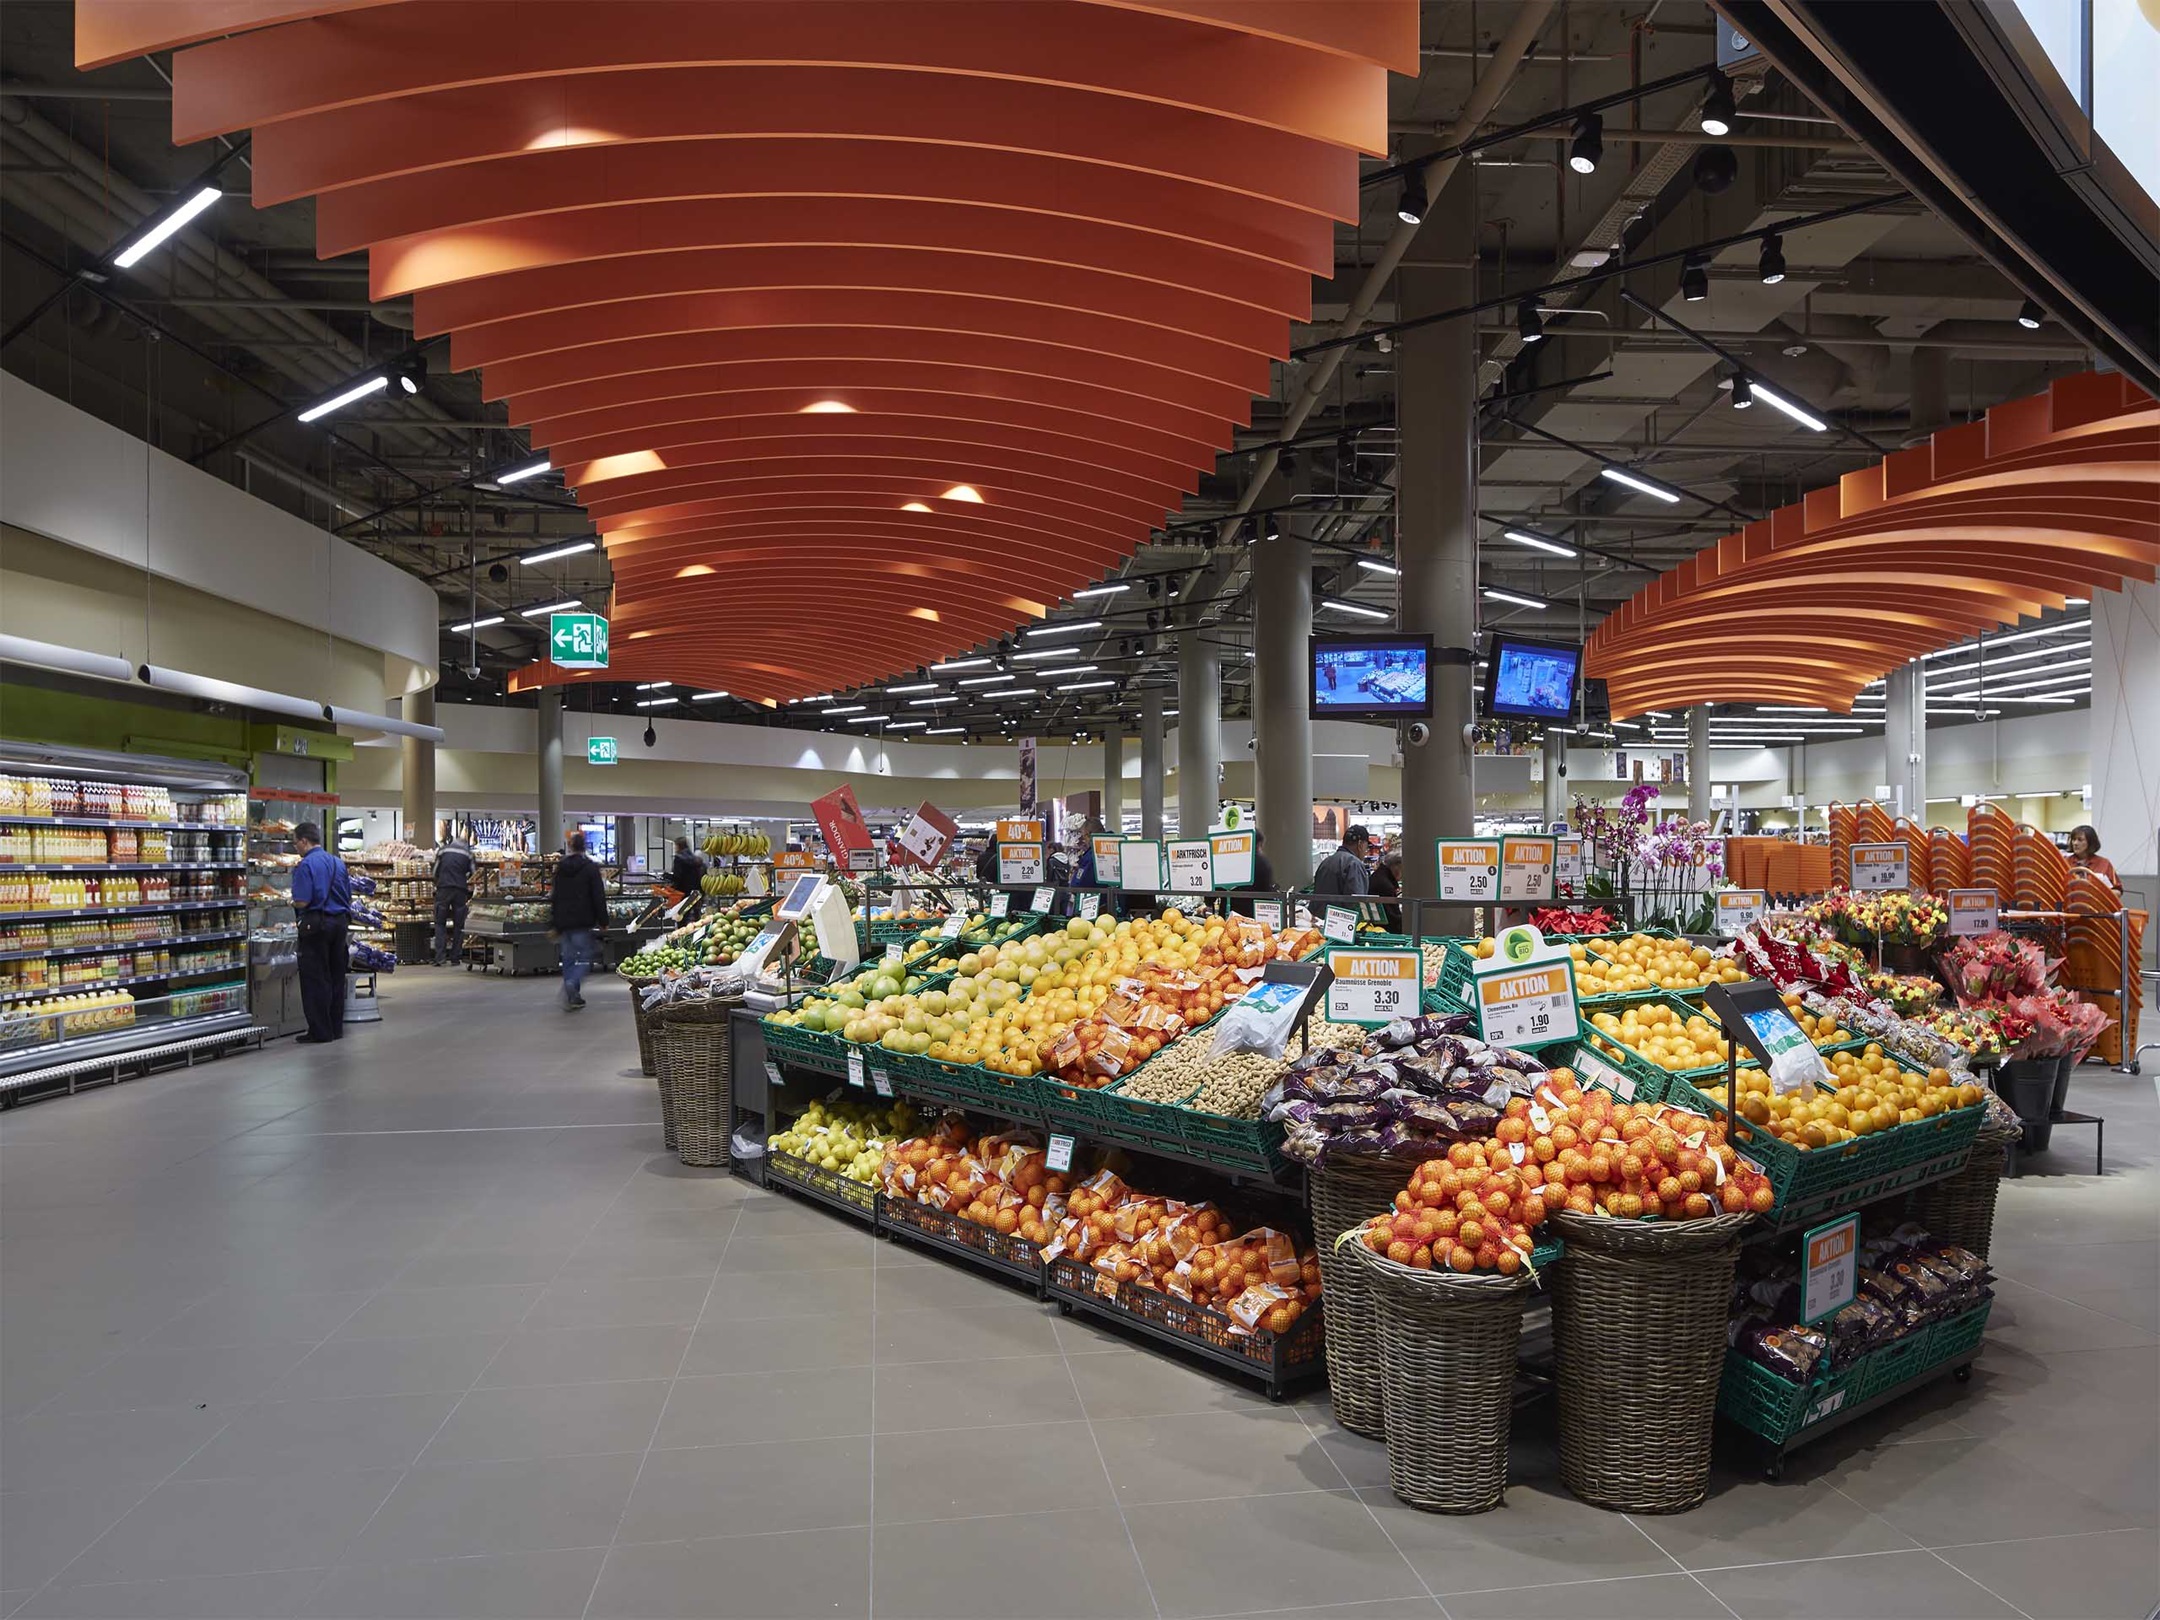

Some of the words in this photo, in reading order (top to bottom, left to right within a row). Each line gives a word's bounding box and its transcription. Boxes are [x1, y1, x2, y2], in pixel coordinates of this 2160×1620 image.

[1008, 824, 1031, 840] 40%
[829, 820, 848, 859] GIANDOR
[1218, 839, 1243, 853] AKTION
[1009, 849, 1032, 858] AKTION
[1171, 849, 1207, 861] MARKTFRISCH
[1453, 848, 1486, 863] AKTION
[1514, 845, 1543, 861] AKTION
[1864, 851, 1894, 862] AKTION
[783, 854, 805, 866] 40%
[1190, 876, 1203, 887] 3.20
[1470, 875, 1488, 888] 2.50
[1526, 874, 1542, 887] 2.50
[1727, 896, 1753, 906] AKTION
[1961, 897, 1987, 907] AKTION
[1973, 919, 1989, 928] 17.90
[1350, 959, 1399, 976] AKTION
[1499, 974, 1550, 999] AKTION
[1374, 990, 1400, 1004] 3.30
[1530, 1013, 1549, 1027] 1.90
[1819, 1232, 1845, 1263] AKTION
